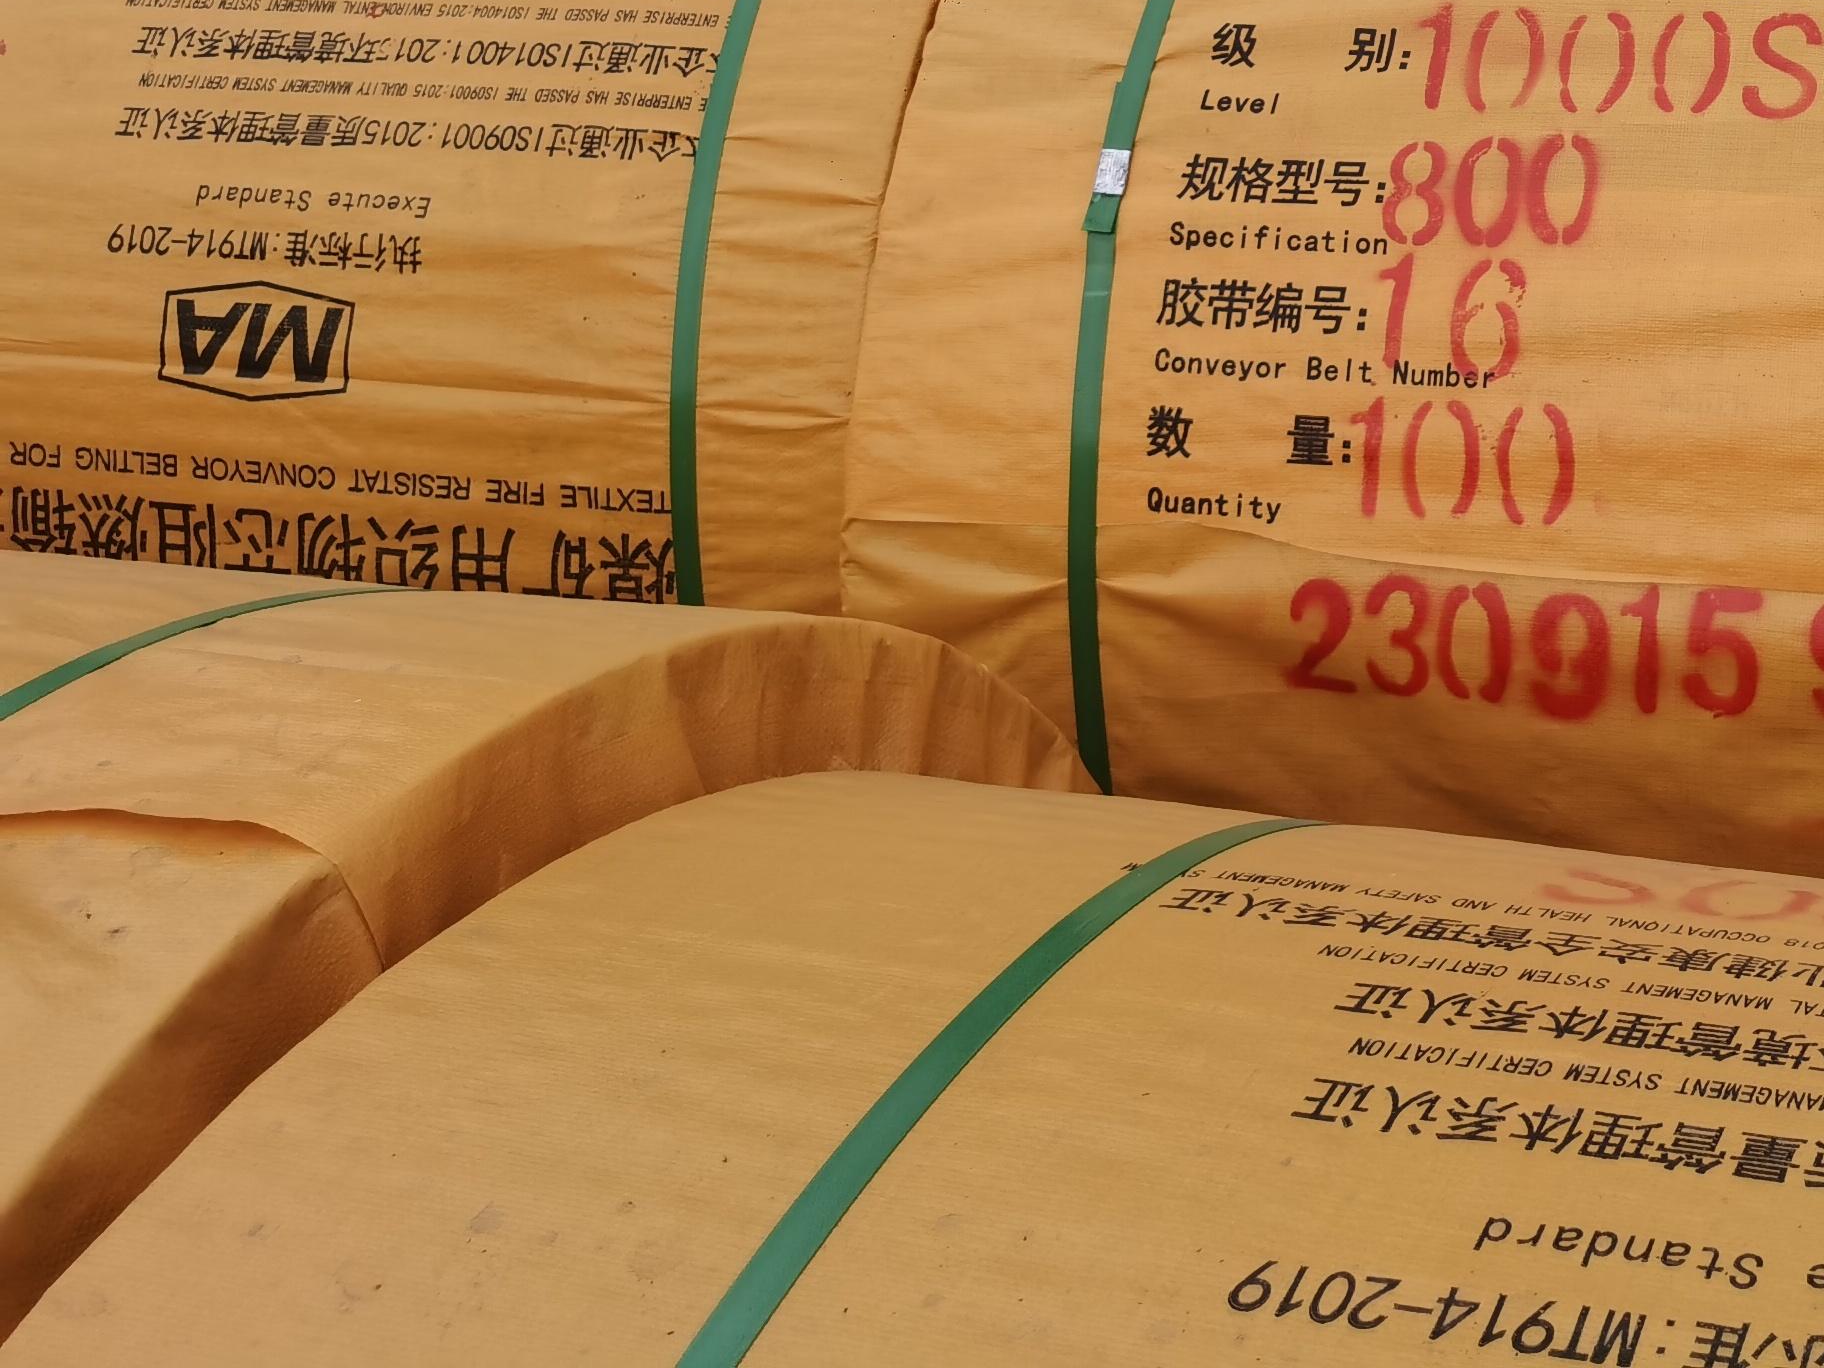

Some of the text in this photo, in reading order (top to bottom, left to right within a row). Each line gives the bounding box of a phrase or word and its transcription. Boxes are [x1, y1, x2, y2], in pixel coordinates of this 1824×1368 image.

[1211, 1, 1824, 120] 级 别: 1000S
[358, 80, 408, 97] QUALITY
[1200, 89, 1281, 115] Level
[195, 183, 432, 219] Execute Standard
[1176, 133, 1603, 248] 规格型号: 800
[107, 223, 423, 275] 执行标准:MT914-2019
[1168, 222, 1390, 257] Specification
[1155, 252, 1530, 382] 胶带编号: 16
[1153, 347, 1496, 390] Conveyor Belt Number
[9, 440, 673, 514] TEXTILE FIRE RESISTAT CONVEYOR BELTING FOR
[1145, 393, 1576, 527] 数 量: 100
[1146, 487, 1283, 525] Quantity
[0, 485, 677, 605] 煤矿用织物芯阻燃输
[1357, 886, 1595, 923] HEALTH SAFETY
[1348, 1037, 1553, 1078] CERTIFICATION
[1566, 1065, 1663, 1092] SYSTEM
[1472, 1215, 1764, 1290] Standard
